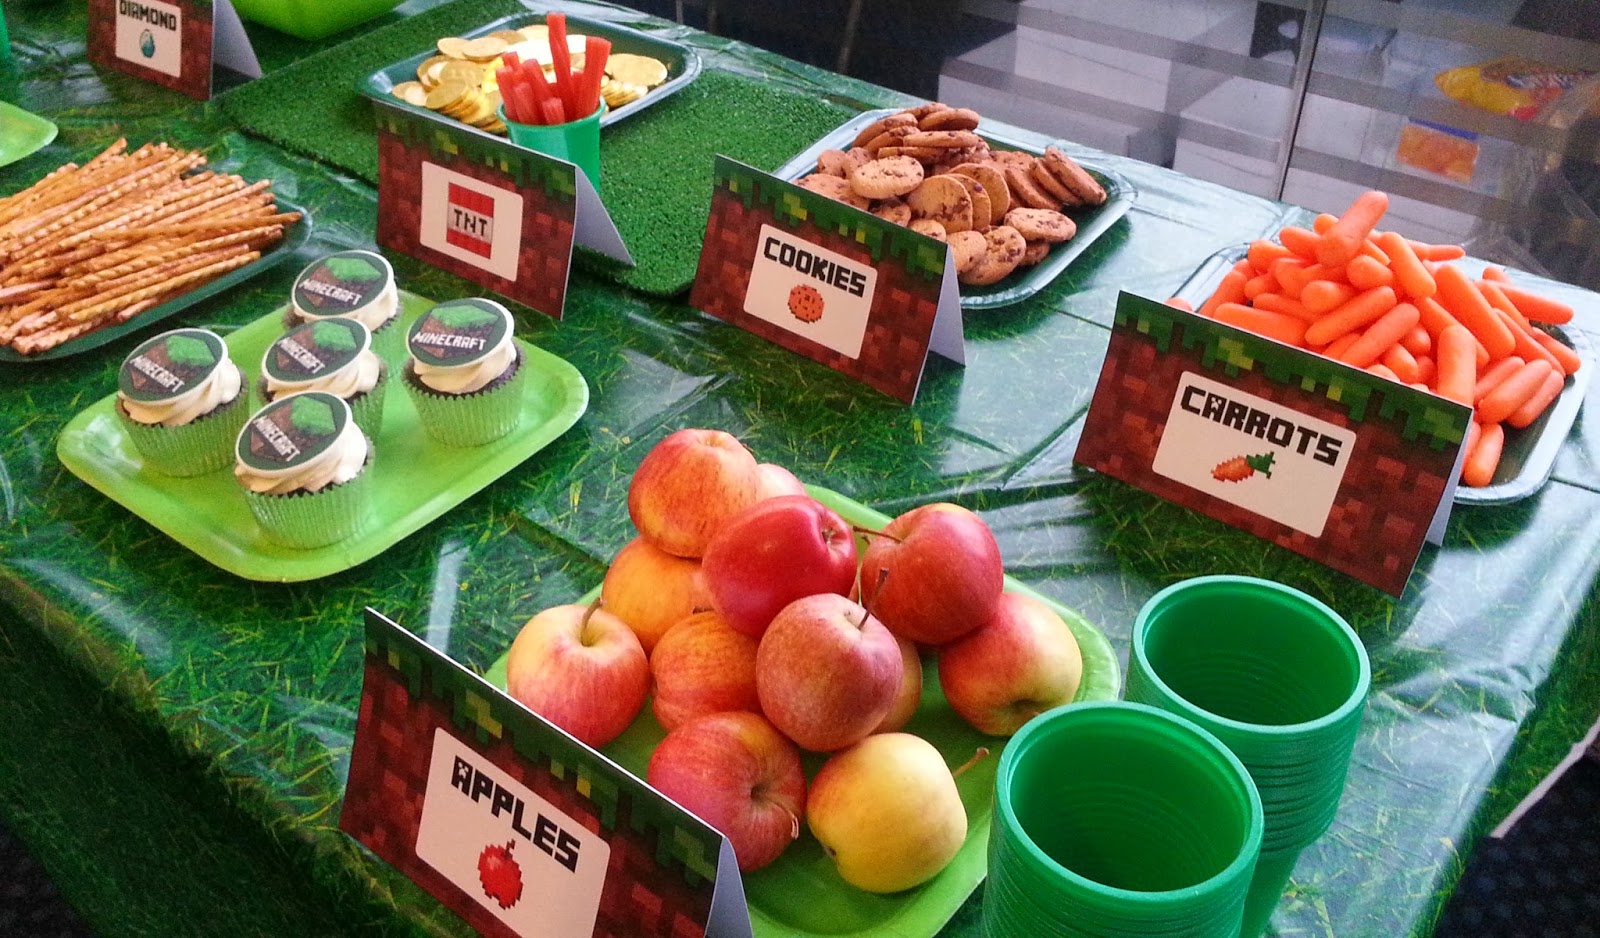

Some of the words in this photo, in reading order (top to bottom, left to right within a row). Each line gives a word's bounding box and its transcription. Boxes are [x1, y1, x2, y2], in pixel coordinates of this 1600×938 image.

[119, 0, 177, 31] DIAMOND
[454, 208, 488, 236] TNT
[763, 236, 867, 298] COOKIES
[299, 278, 363, 306] MINECRAFT
[277, 337, 326, 374] MINECRAFT
[411, 331, 487, 352] MINECRAFT
[129, 353, 186, 393] MINECRAFT
[252, 415, 301, 462] MINECRAFT
[1180, 385, 1343, 467] CARROTS
[451, 755, 581, 873] APPLES
